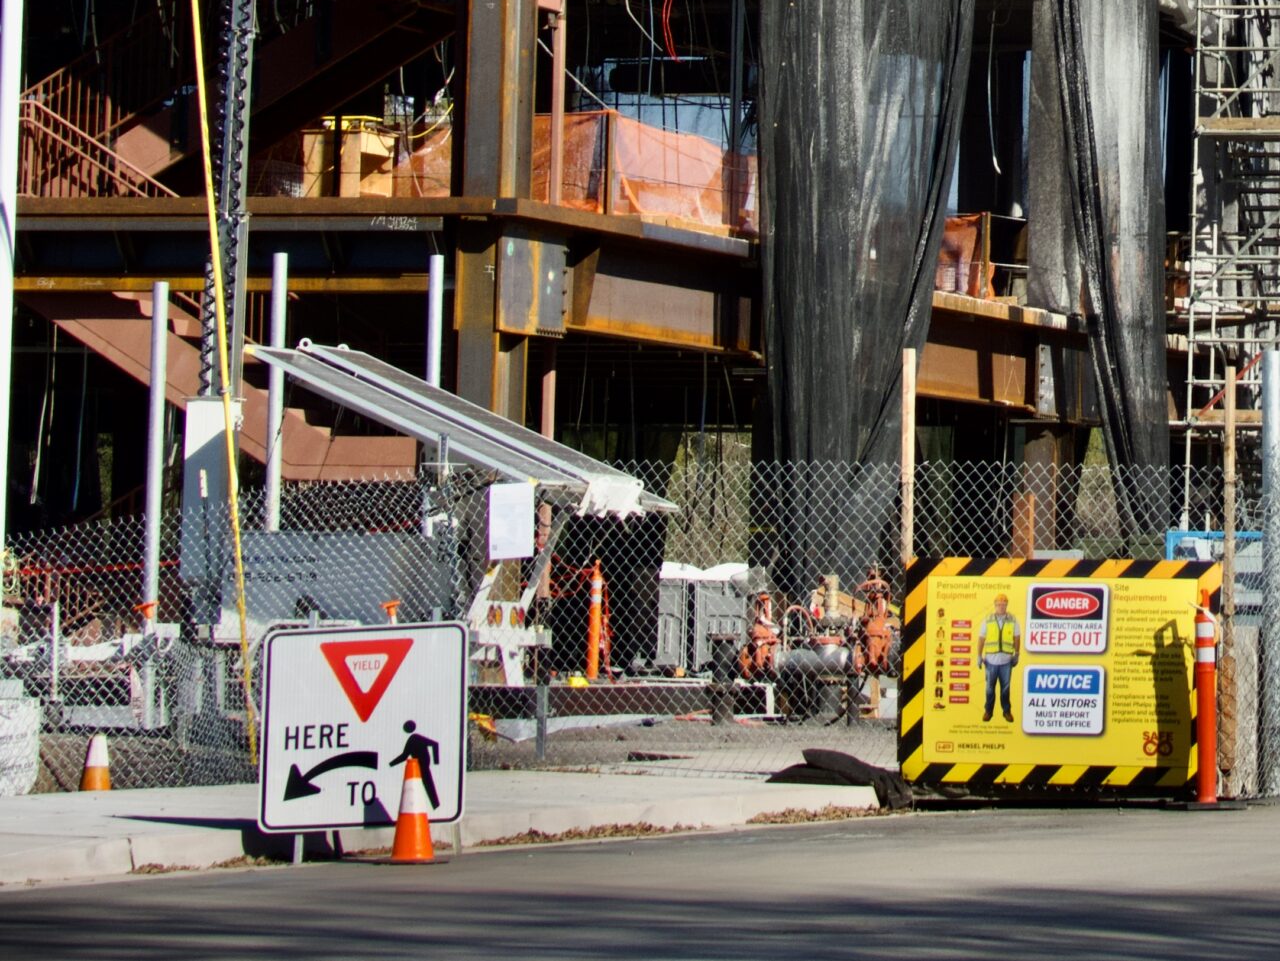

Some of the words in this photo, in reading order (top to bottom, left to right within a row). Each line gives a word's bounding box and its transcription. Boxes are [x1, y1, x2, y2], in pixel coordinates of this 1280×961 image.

[936, 581, 971, 590] Personal
[972, 582, 1011, 590] Protective
[1114, 583, 1129, 591] Site
[936, 591, 977, 600] Equipment
[1113, 594, 1167, 602] Requirements
[1046, 598, 1089, 610] DANGER
[1030, 622, 1082, 630] CONSTRUCTION
[1030, 630, 1067, 645] KEEP
[1072, 631, 1102, 646] OUT
[352, 659, 380, 671] YIELD
[1035, 674, 1093, 689] NOTICE
[1028, 698, 1047, 707] ALL
[1050, 698, 1097, 708] VISITORS
[1065, 720, 1091, 728] OFFICE
[284, 723, 349, 750] HERE
[1142, 731, 1174, 740] SAFE
[347, 780, 377, 806] TO
